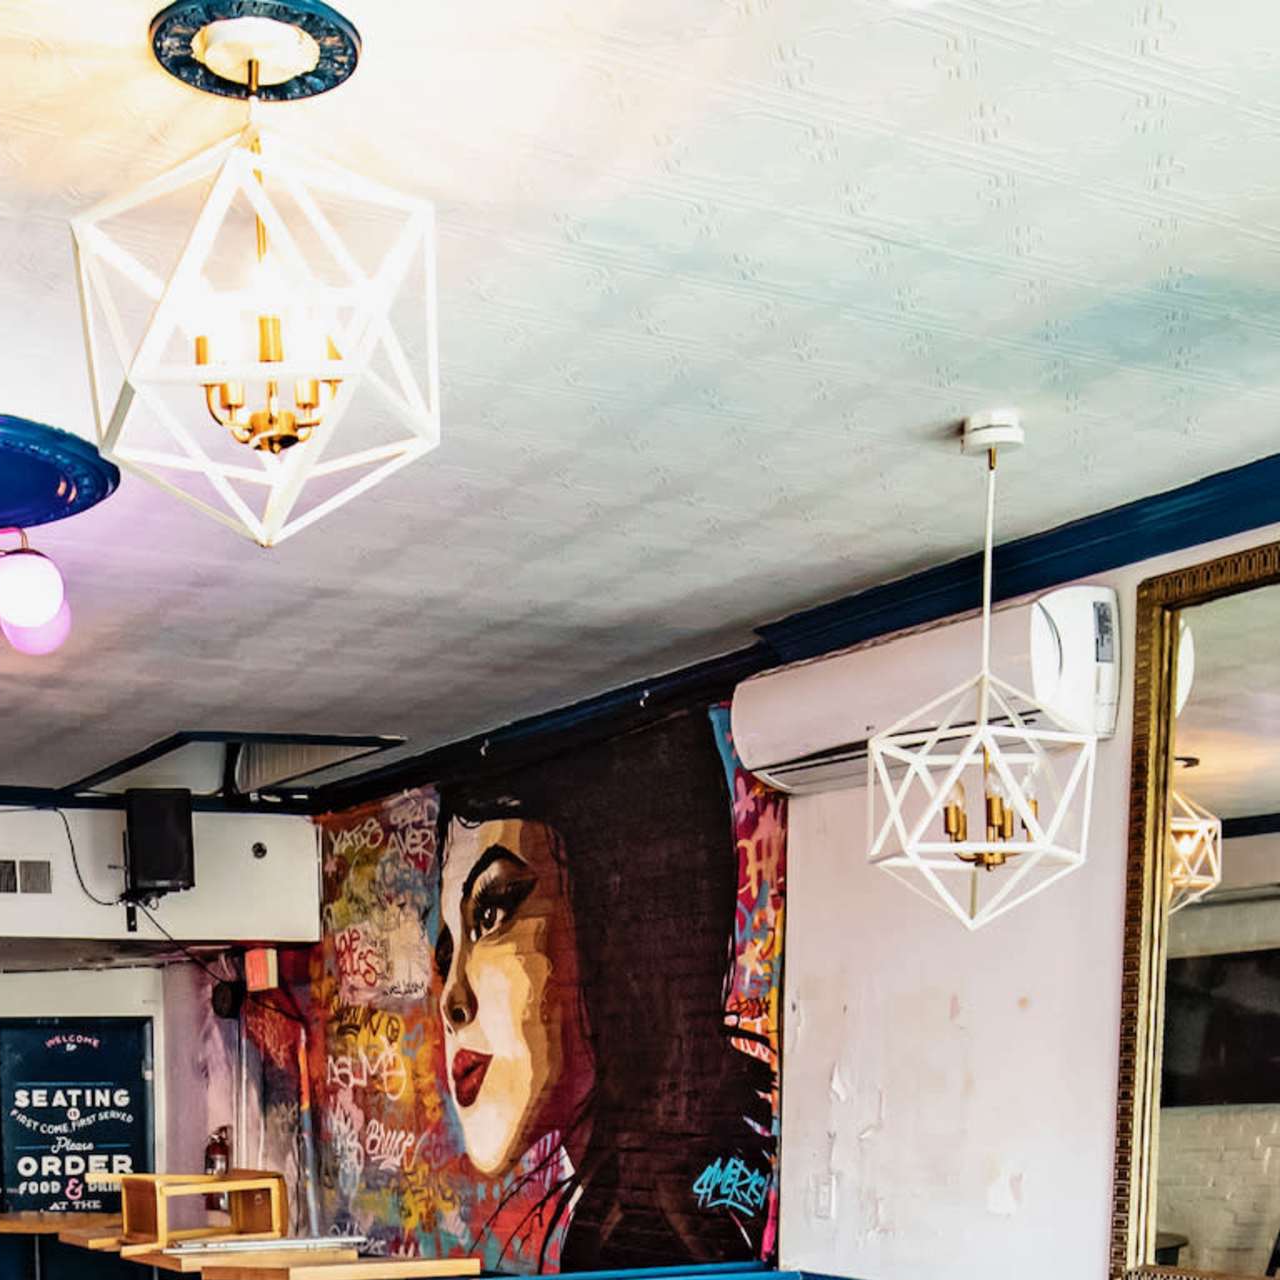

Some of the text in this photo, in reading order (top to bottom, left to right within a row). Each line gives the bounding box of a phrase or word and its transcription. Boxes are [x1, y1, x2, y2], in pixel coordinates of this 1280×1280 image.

[45, 1034, 100, 1048] WELCOME
[14, 1089, 130, 1108] SEATING
[10, 1109, 40, 1131] FIRST
[71, 1113, 97, 1131] FIRST
[98, 1110, 134, 1123] SERVED
[51, 1136, 94, 1154] Please
[17, 1155, 133, 1177] ORDER
[19, 1181, 61, 1195] FOOD
[65, 1178, 83, 1200] &
[49, 1200, 102, 1210] AT THE
